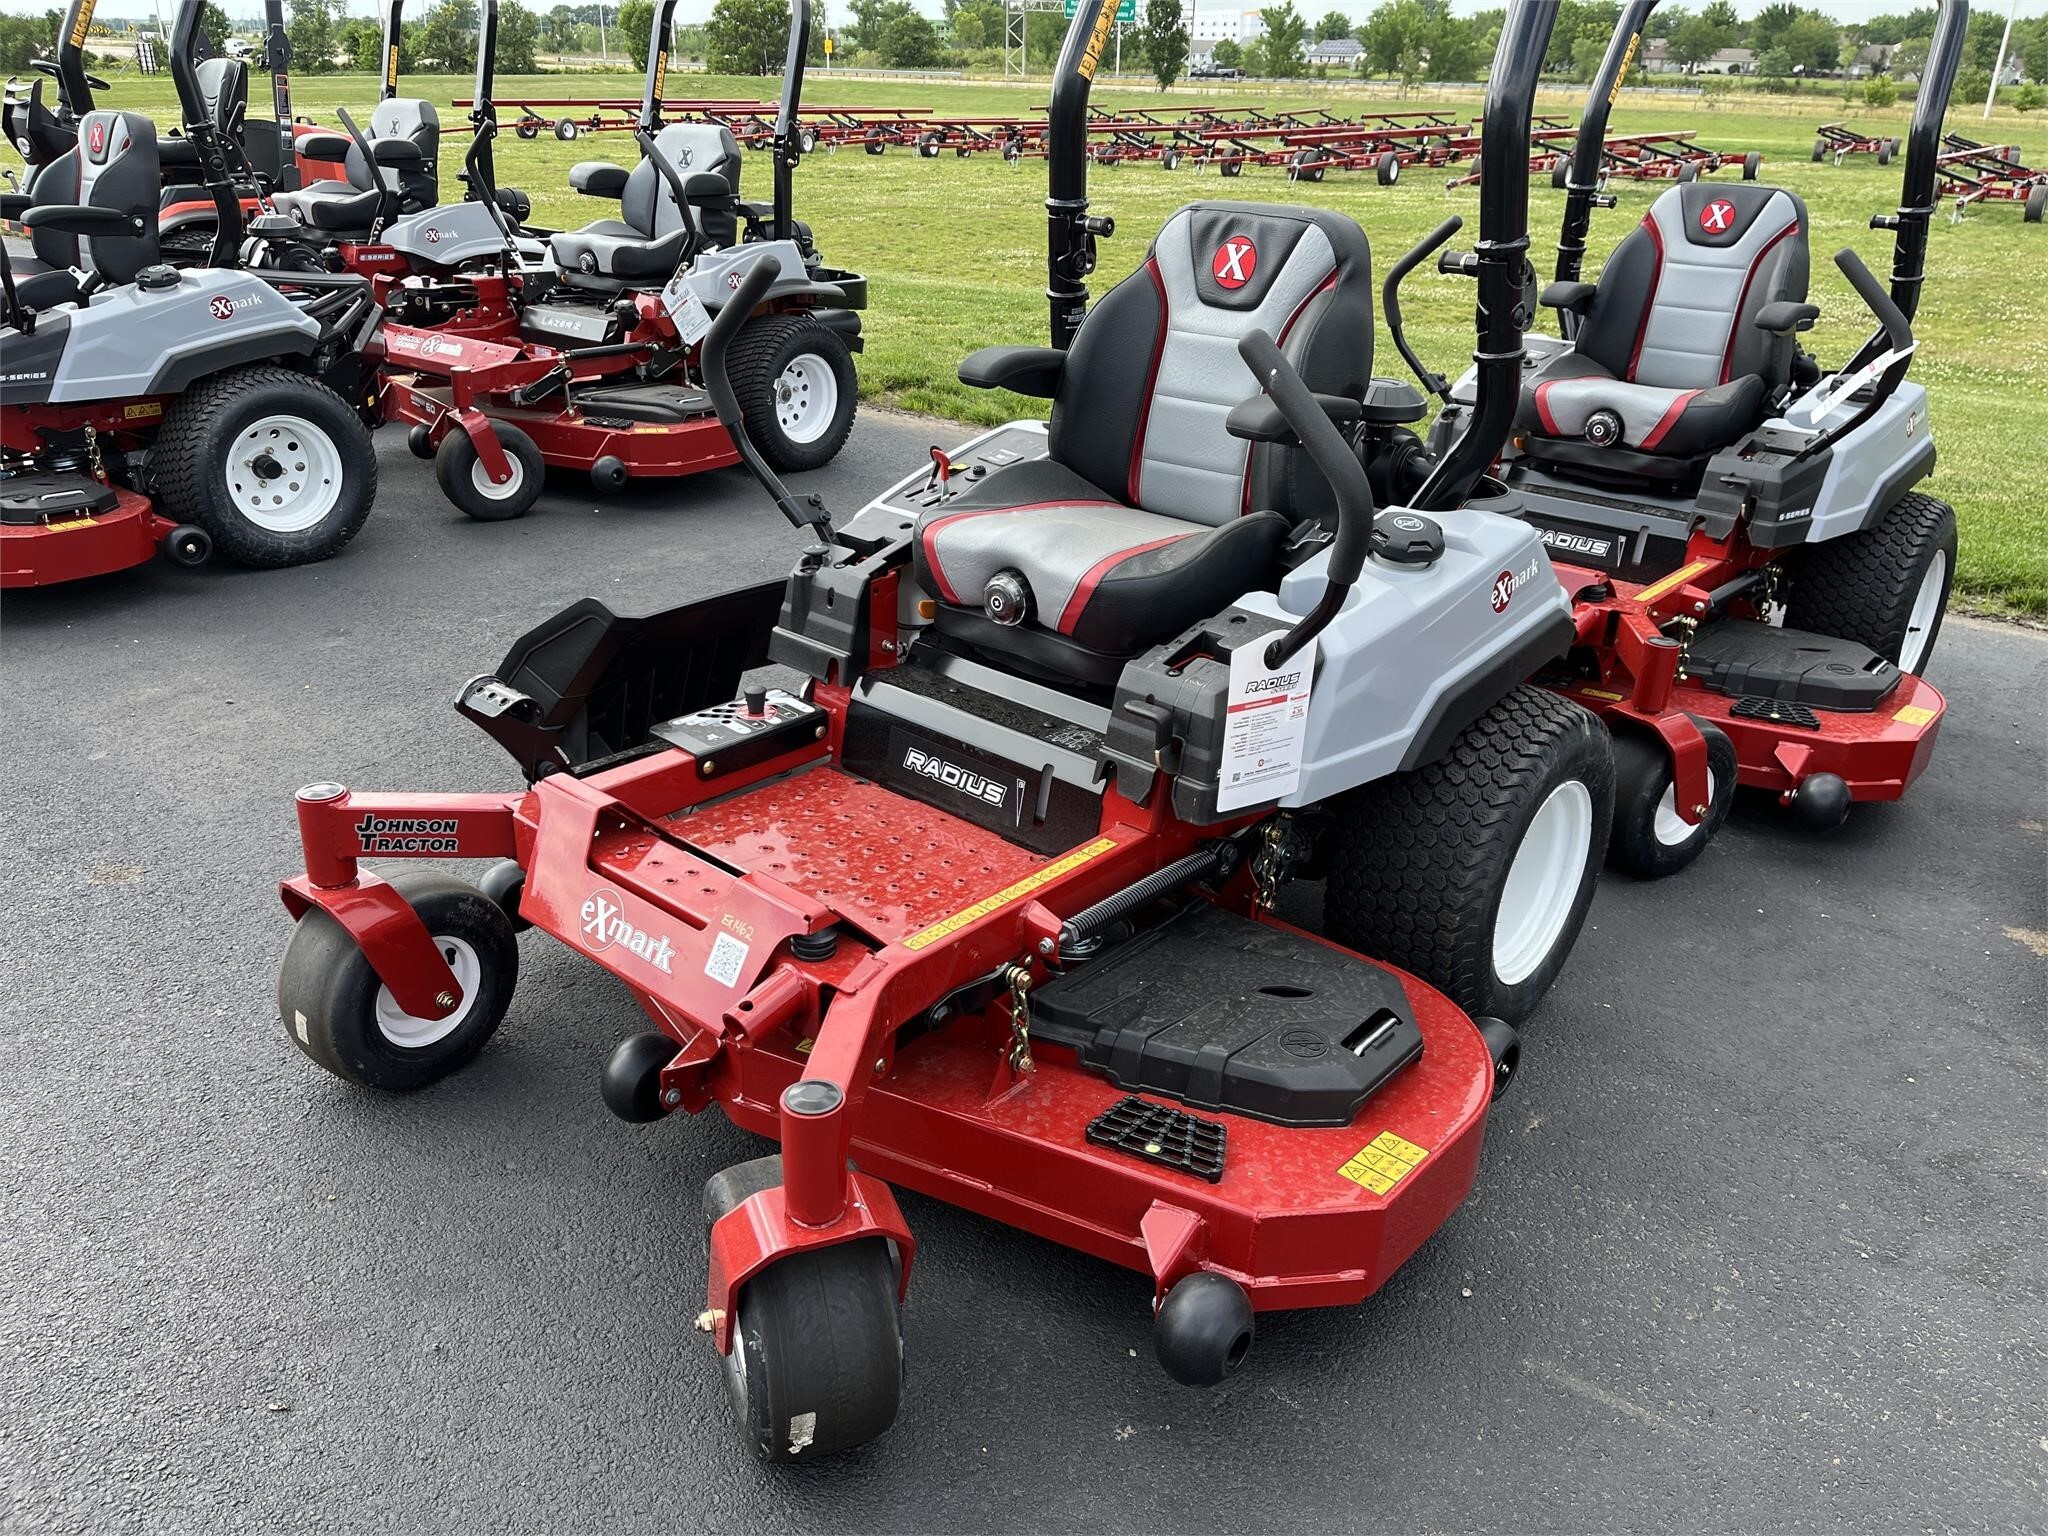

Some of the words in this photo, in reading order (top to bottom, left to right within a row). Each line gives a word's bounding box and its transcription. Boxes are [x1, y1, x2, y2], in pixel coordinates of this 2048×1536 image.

[1703, 203, 1732, 229] X
[1216, 242, 1252, 281] X
[210, 293, 263, 317] eXmark
[1491, 558, 1539, 609] eXmark
[1245, 672, 1300, 694] RADIUS
[904, 747, 1007, 807] RADIUS
[355, 814, 459, 834] JOHNSON
[358, 832, 459, 852] TRACTOR
[581, 895, 677, 975] eXmark
